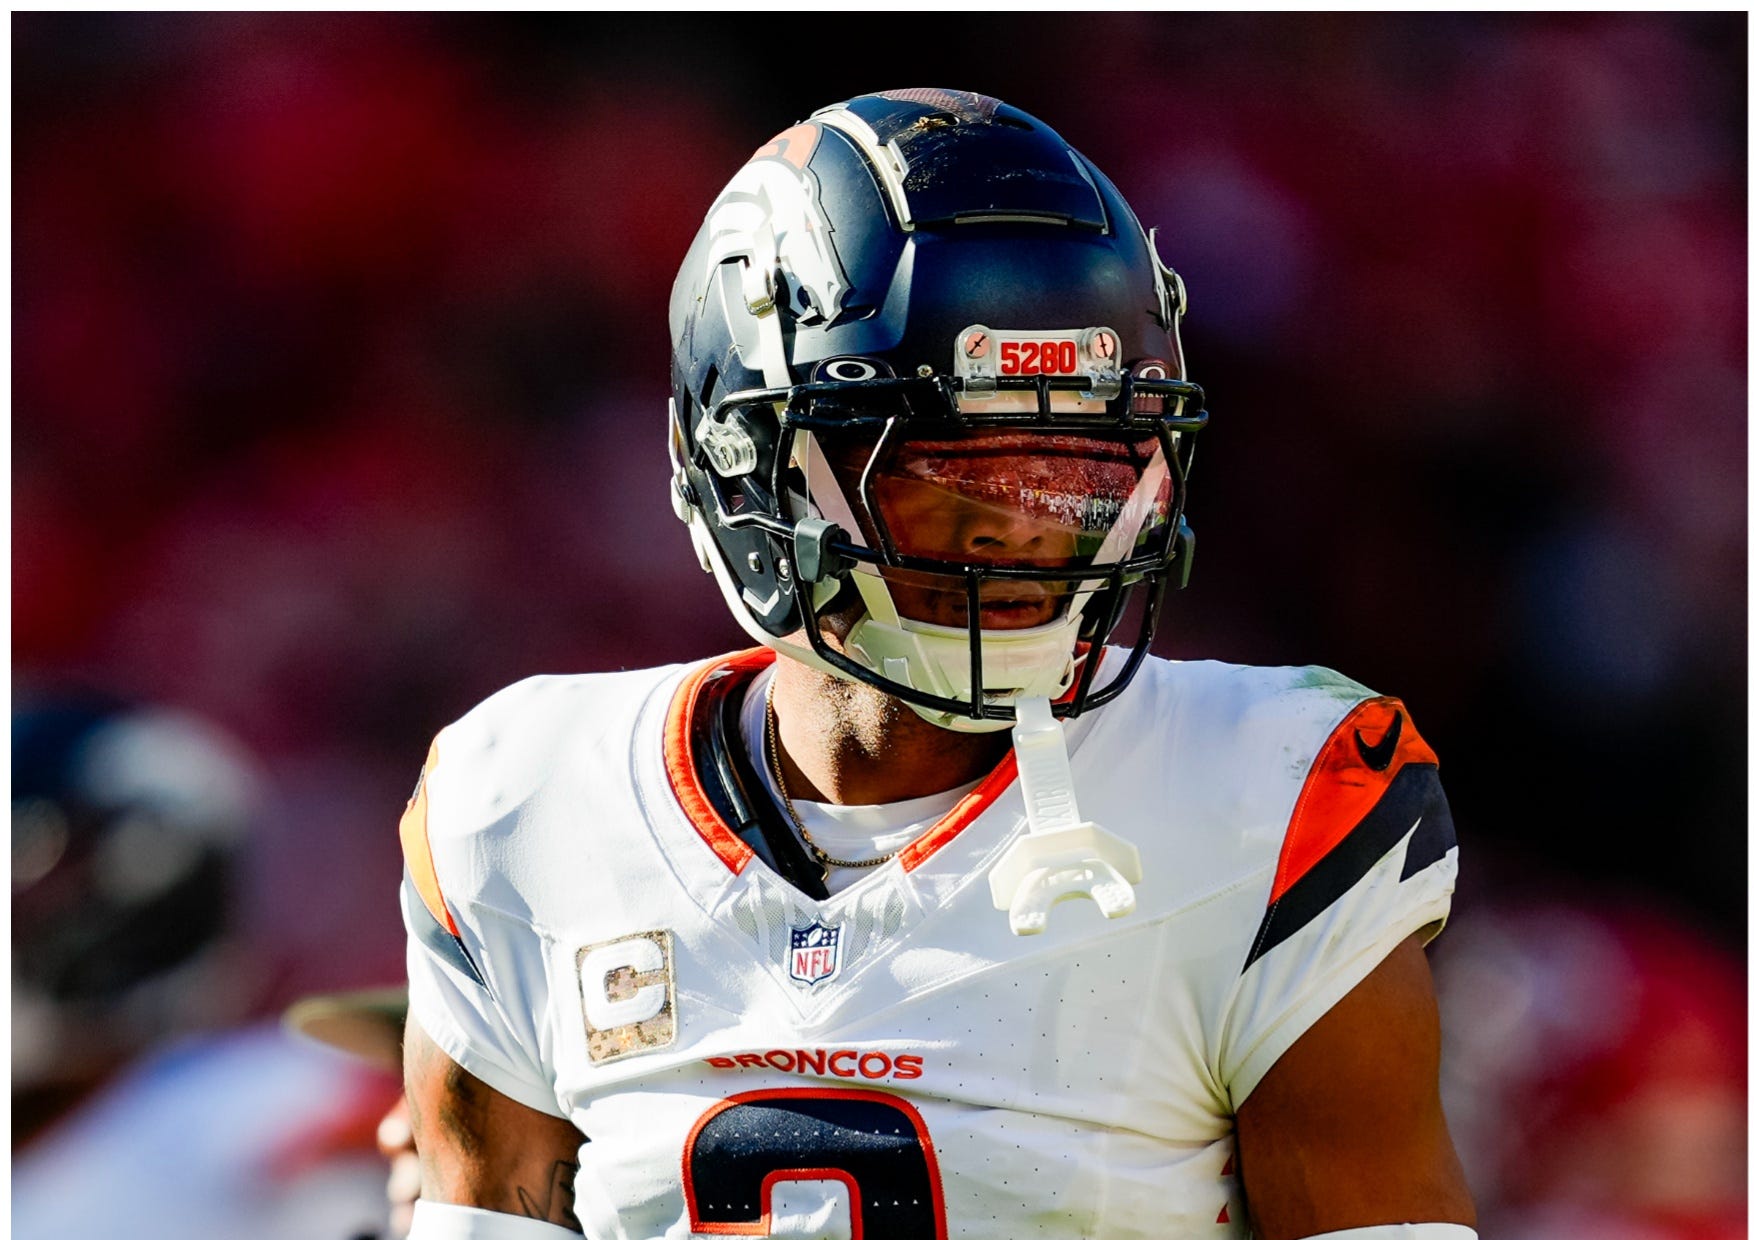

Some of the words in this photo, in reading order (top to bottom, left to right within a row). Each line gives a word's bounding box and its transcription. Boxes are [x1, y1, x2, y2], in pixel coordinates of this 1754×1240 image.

[1000, 340, 1077, 375] 5280
[795, 947, 834, 976] NFL
[580, 936, 668, 1032] C
[704, 1048, 924, 1080] BRONCOS
